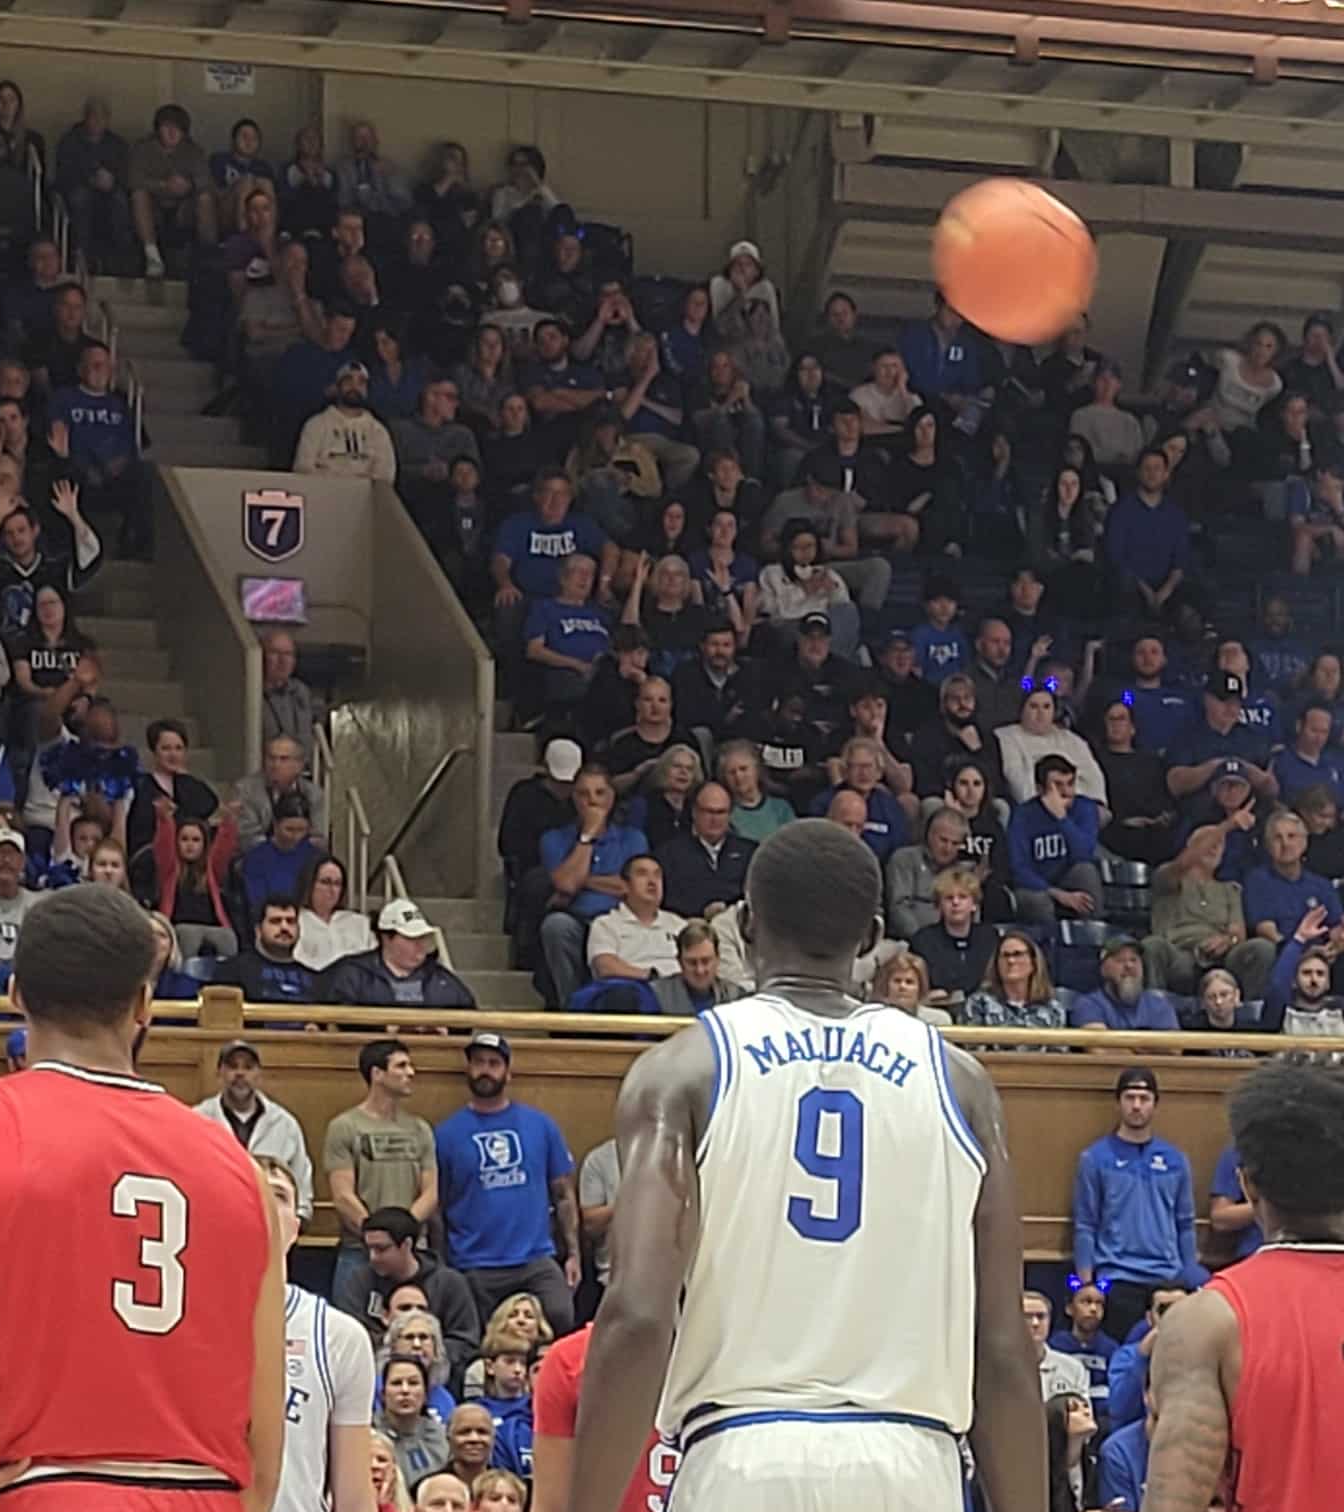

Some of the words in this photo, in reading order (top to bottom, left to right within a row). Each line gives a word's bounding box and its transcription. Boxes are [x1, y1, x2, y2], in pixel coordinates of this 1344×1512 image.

[261, 510, 287, 546] 7
[743, 1026, 918, 1087] MALUACH
[785, 1085, 864, 1243] 9
[112, 1173, 189, 1336] 3
